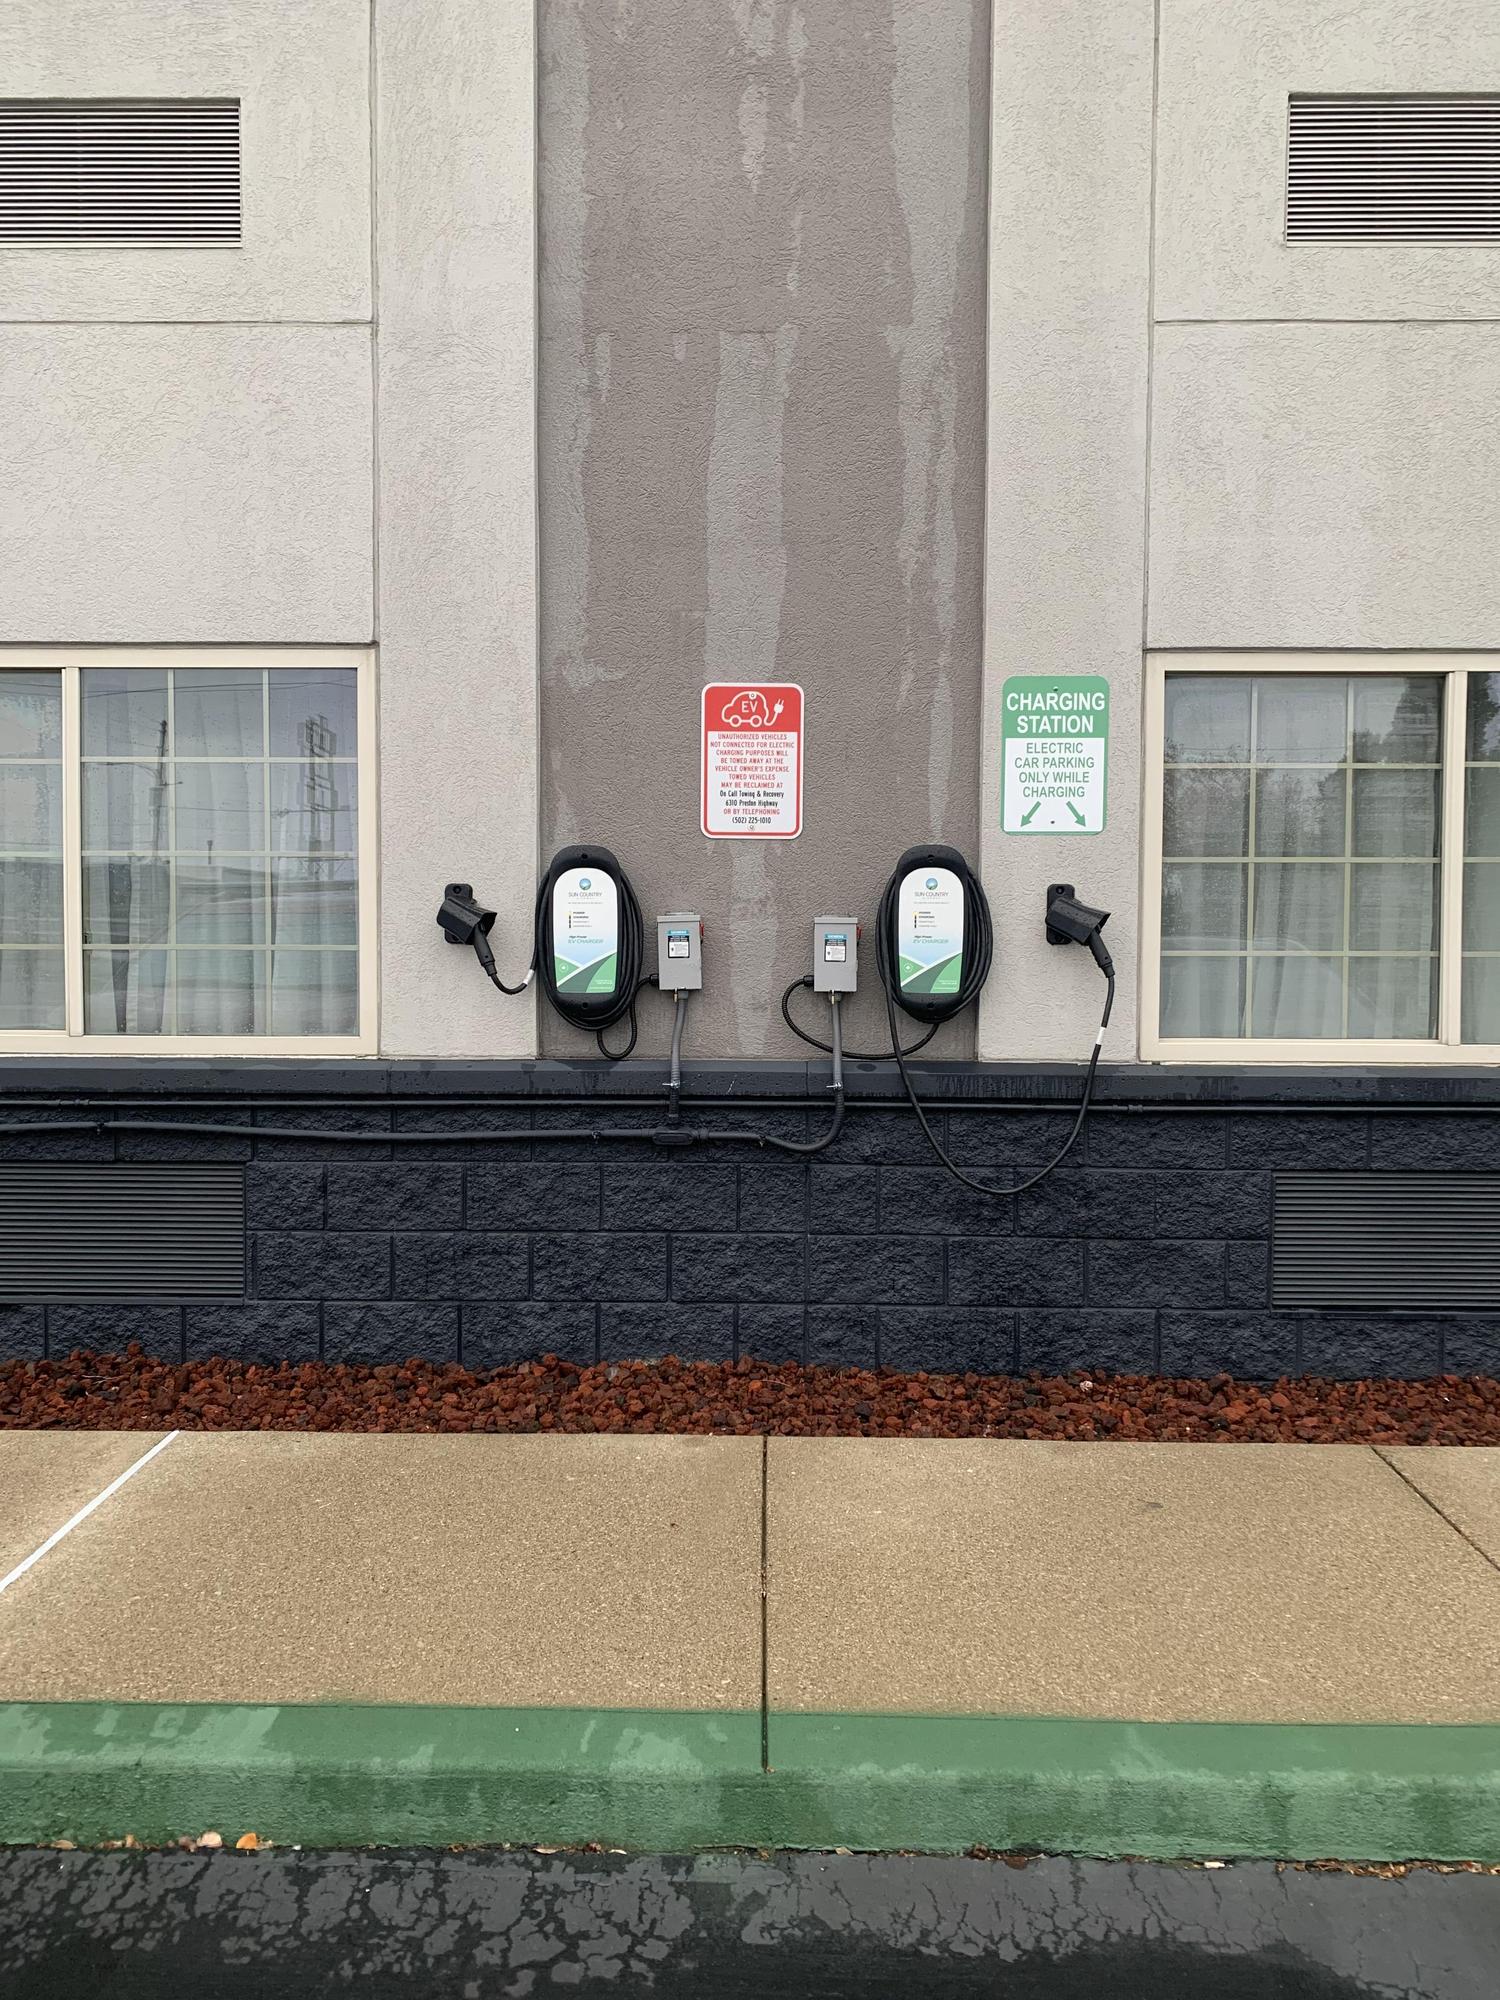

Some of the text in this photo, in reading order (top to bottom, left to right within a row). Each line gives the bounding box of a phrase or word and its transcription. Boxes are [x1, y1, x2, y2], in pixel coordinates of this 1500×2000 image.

[741, 700, 759, 713] EV
[1006, 692, 1106, 711] CHARGING
[1016, 715, 1095, 734] STATION
[710, 741, 795, 749] NOT CONNECTED FOR ELECTRIC
[1026, 742, 1084, 755] ELECTRIC
[715, 749, 789, 757] CHARGING PURPOSES WILL
[1014, 757, 1095, 769] CAR PARKING
[1018, 771, 1090, 784] ONLY WHILE
[739, 790, 756, 799] Towing
[756, 790, 762, 798] &
[762, 790, 785, 799] Recovery
[1022, 786, 1086, 799] CHARGING
[725, 799, 779, 809] 6310 Preston Highway
[731, 816, 772, 824] (502) 225-1010
